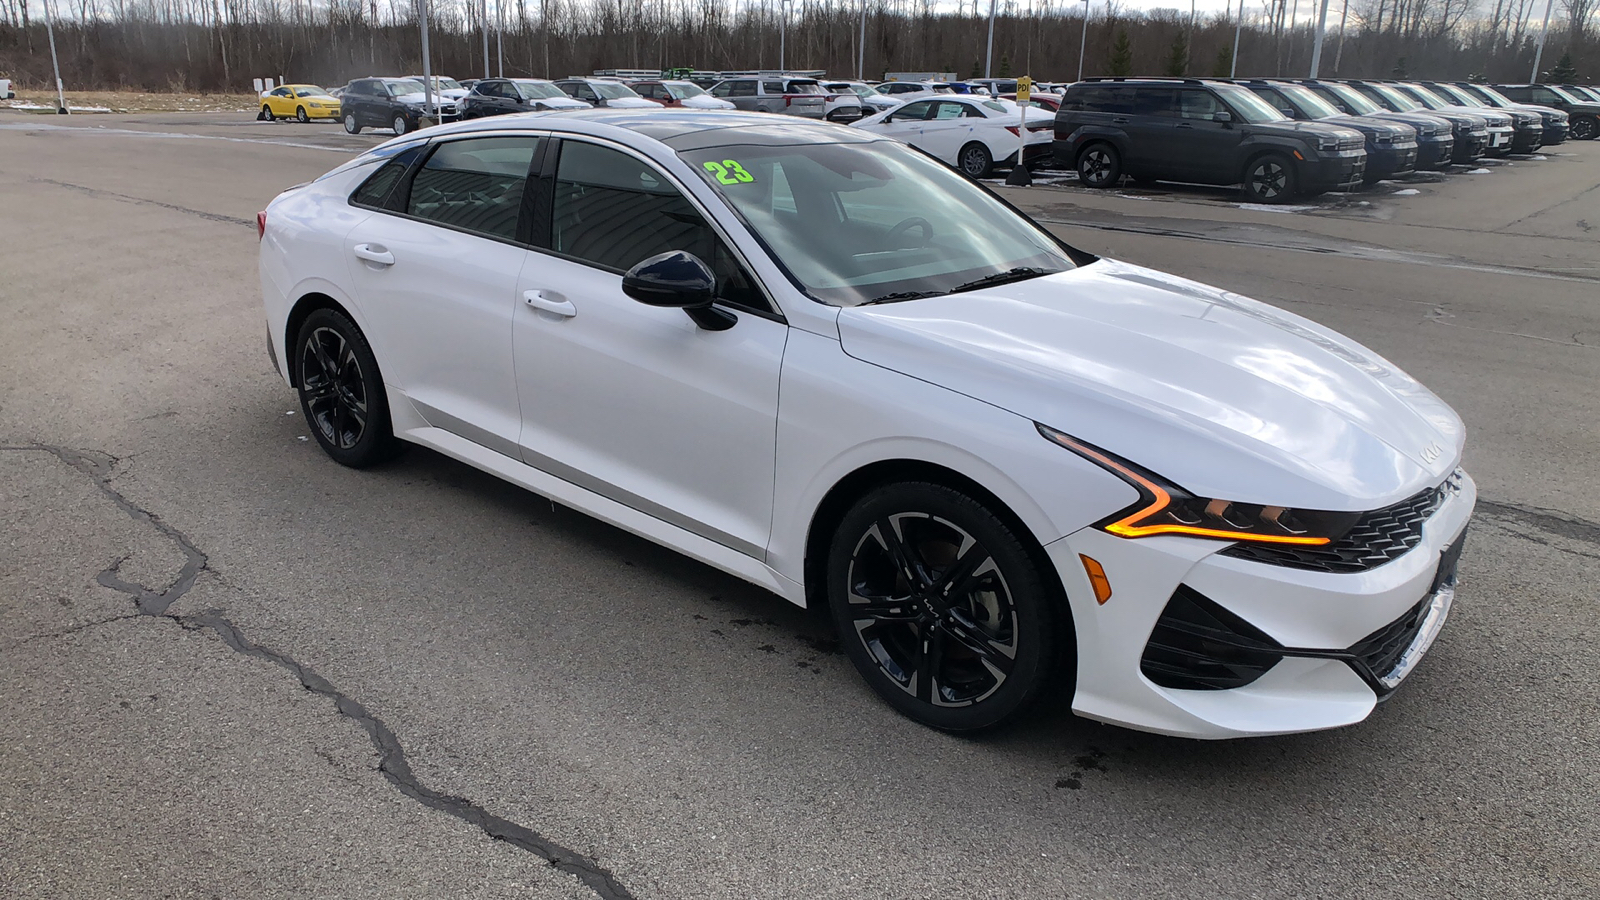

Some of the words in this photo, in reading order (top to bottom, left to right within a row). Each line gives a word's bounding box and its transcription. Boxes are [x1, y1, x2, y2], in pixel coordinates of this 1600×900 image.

[1018, 83, 1030, 92] PDI
[703, 159, 754, 186] 23
[1419, 441, 1444, 465] KIA
